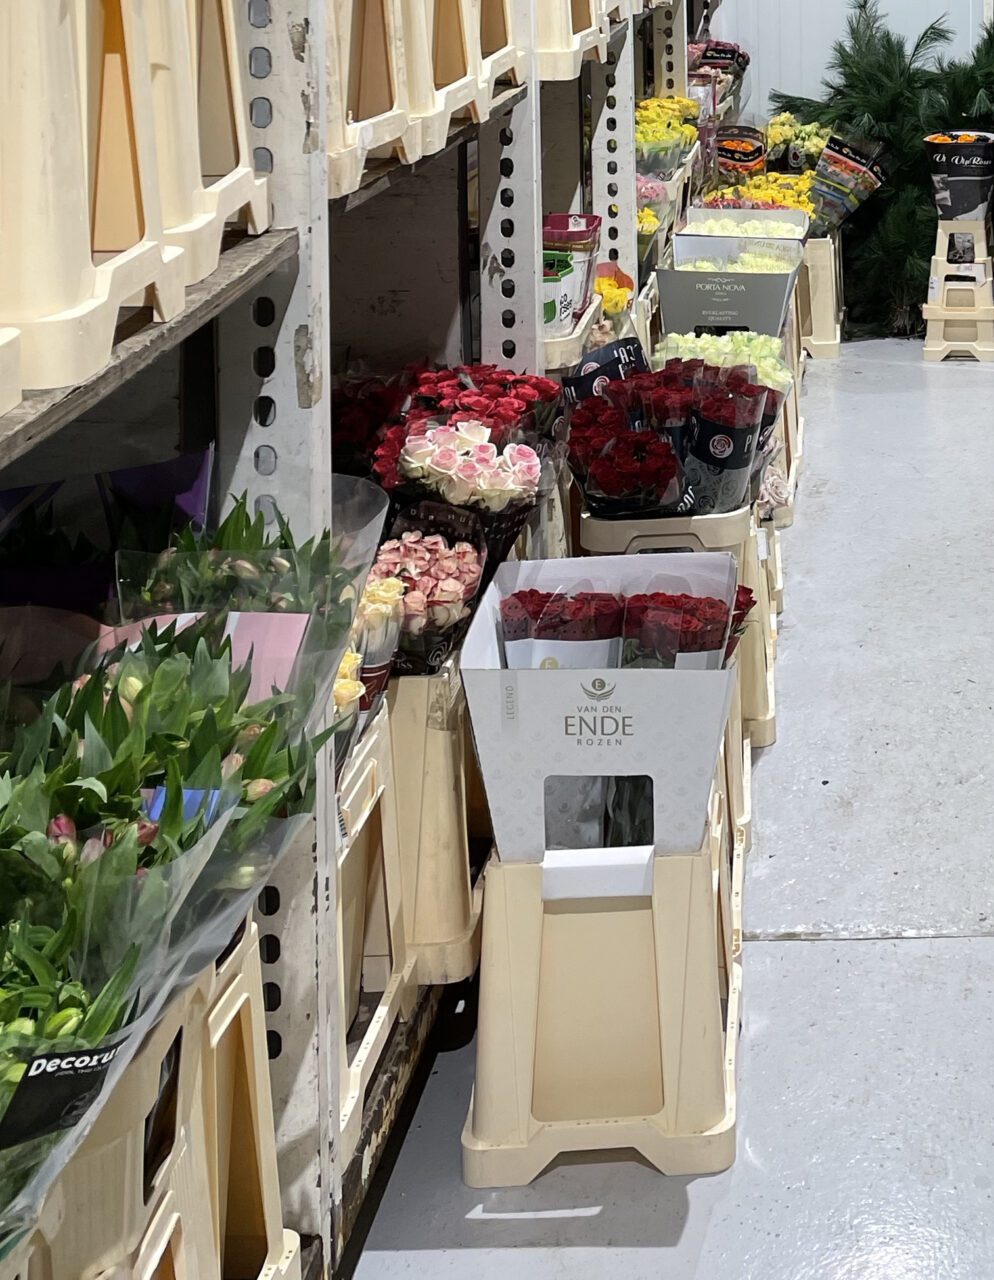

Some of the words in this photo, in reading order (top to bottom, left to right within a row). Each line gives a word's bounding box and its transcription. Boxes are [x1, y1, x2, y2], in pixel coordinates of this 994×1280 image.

[695, 283, 721, 292] PORTA
[722, 284, 746, 292] NOVA
[505, 685, 515, 720] LEGEND
[564, 716, 634, 736] ENDE
[577, 738, 622, 746] ROZEN
